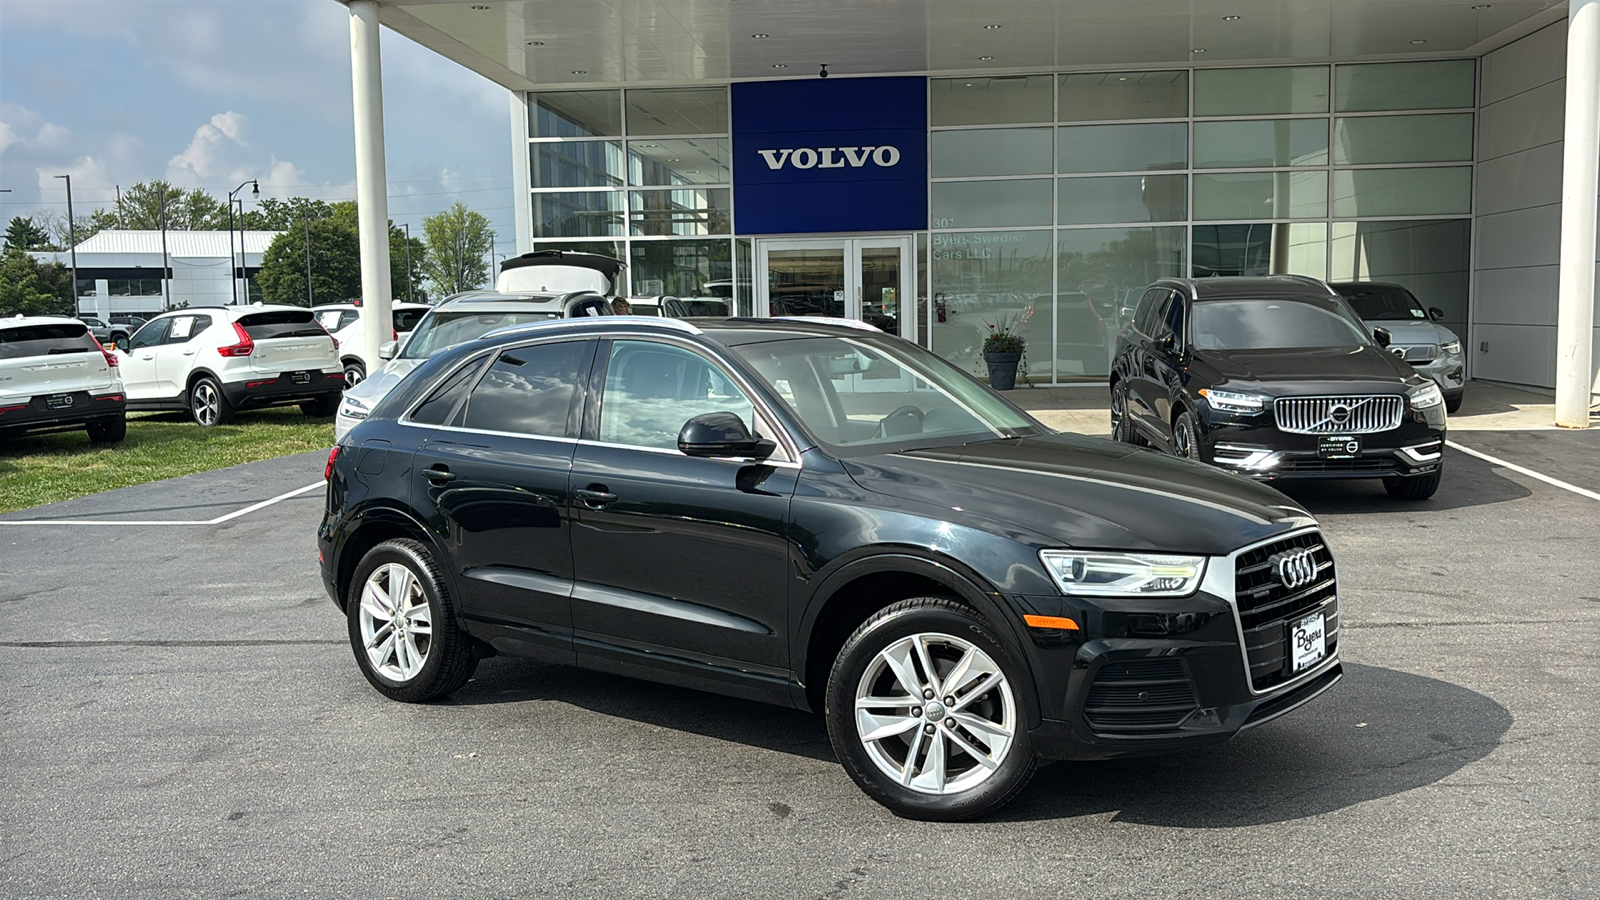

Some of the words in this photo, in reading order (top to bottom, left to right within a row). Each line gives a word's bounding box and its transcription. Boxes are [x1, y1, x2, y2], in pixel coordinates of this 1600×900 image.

[758, 145, 900, 170] VOLVO
[933, 218, 954, 228] 301
[934, 233, 969, 248] Byers
[973, 233, 1027, 244] Swedish
[933, 249, 962, 260] Cars
[966, 247, 991, 259] LLC
[1294, 629, 1322, 651] Byers
